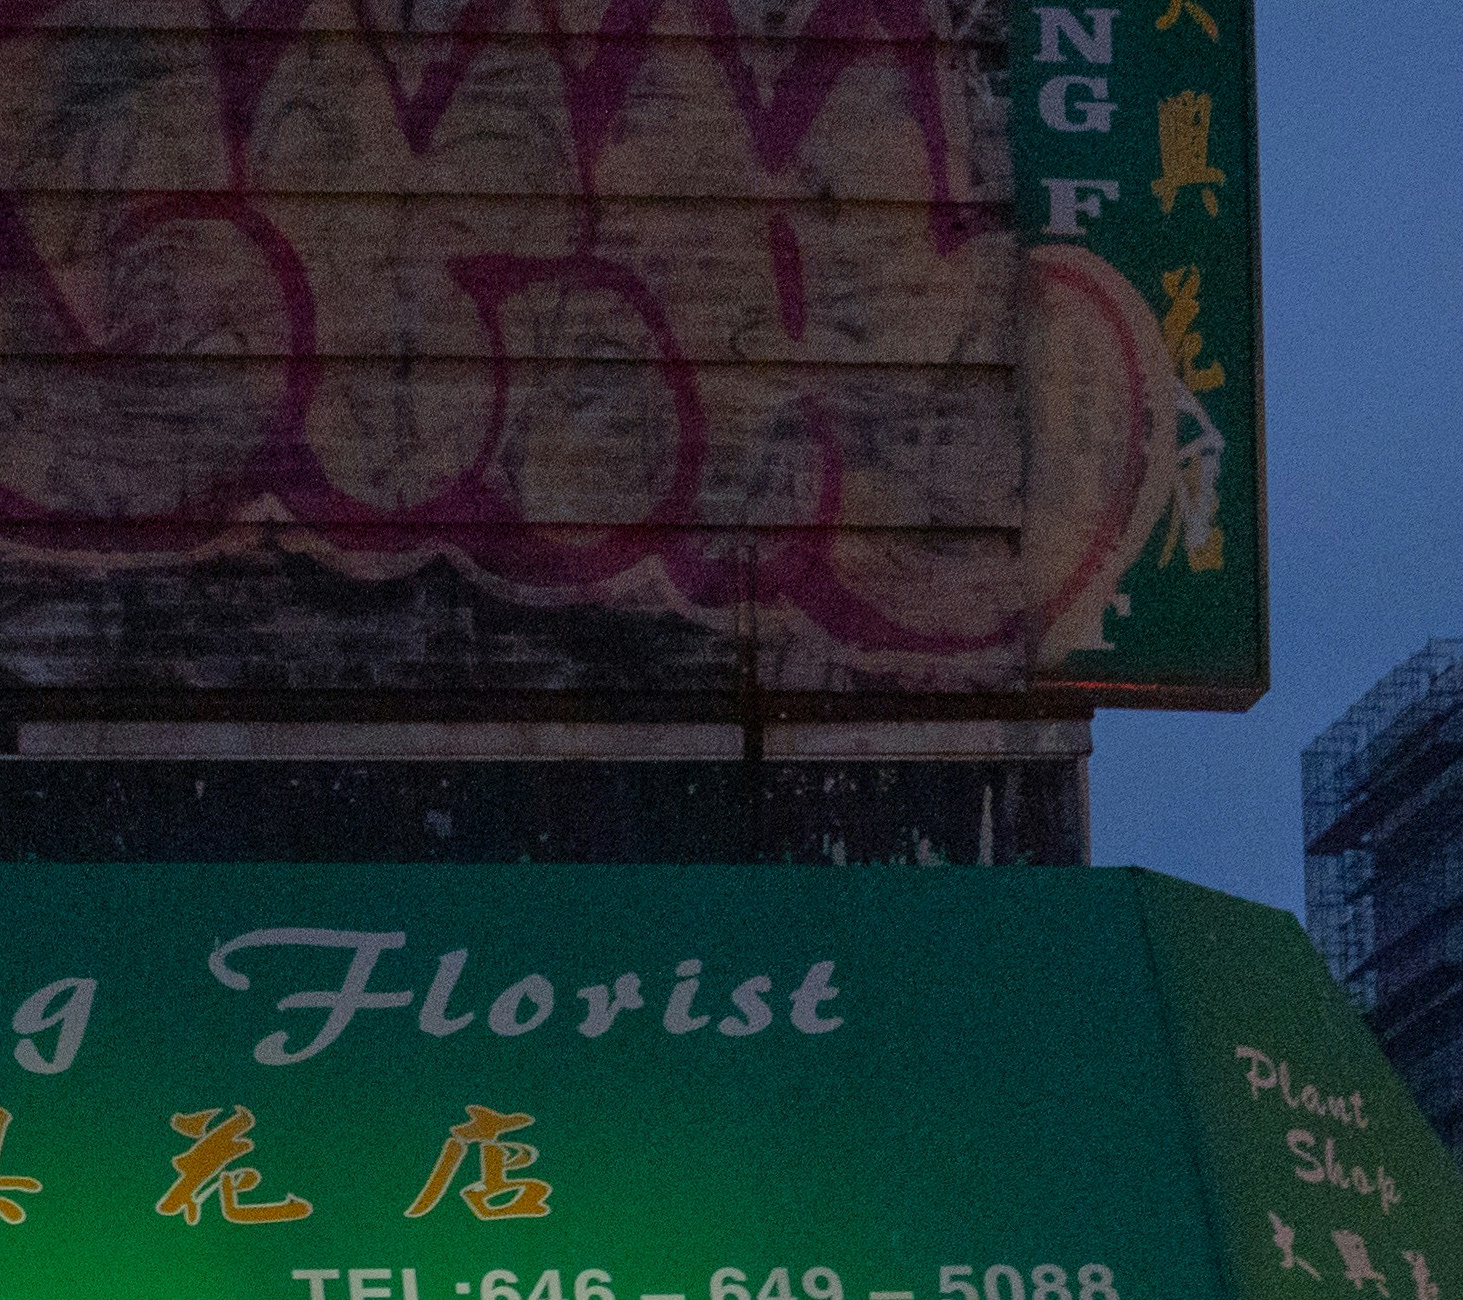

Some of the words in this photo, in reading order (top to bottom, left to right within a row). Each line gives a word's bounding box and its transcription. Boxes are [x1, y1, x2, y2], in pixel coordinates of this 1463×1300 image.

[207, 926, 844, 1067] Florist
[1234, 1045, 1369, 1130] Plant
[1285, 1128, 1401, 1213] Shop
